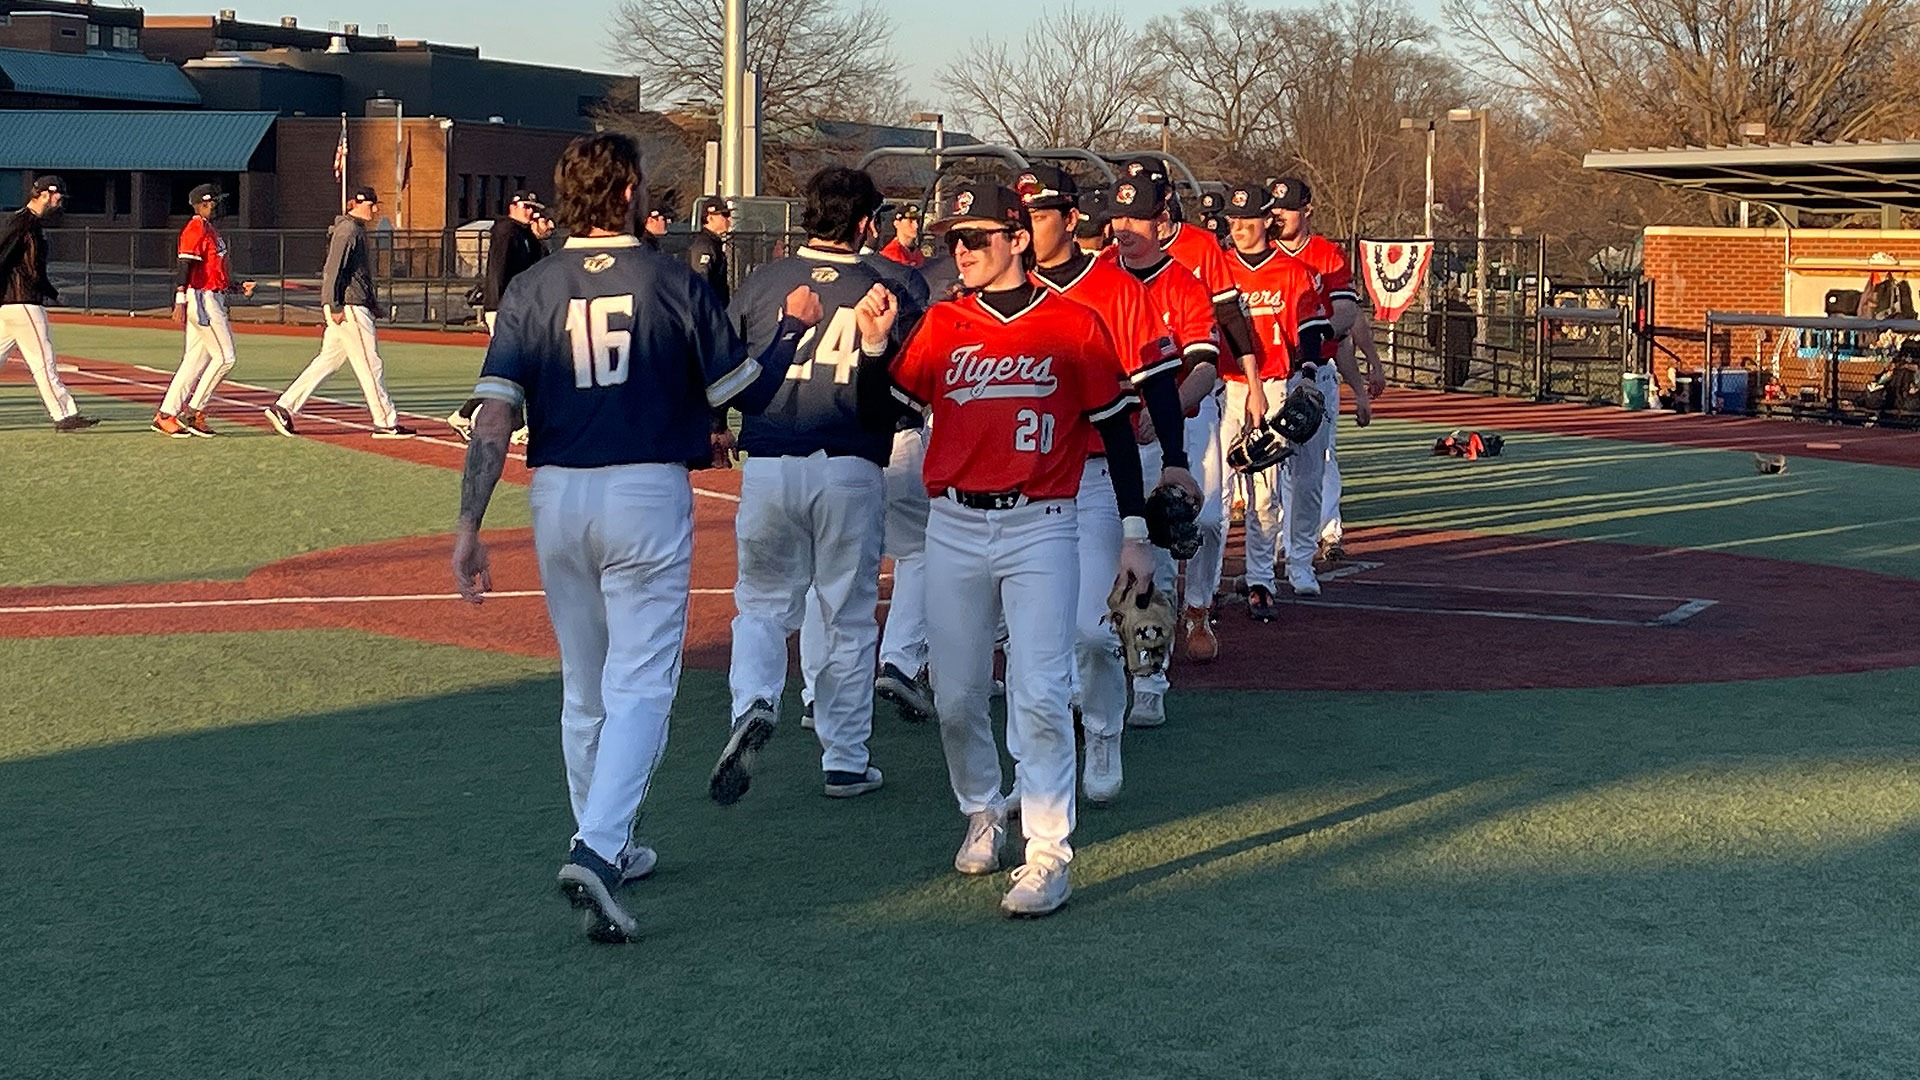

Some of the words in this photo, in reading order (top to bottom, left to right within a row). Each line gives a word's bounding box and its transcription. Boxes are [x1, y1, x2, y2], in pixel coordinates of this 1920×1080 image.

[1237, 284, 1285, 314] gers
[565, 294, 634, 388] 16
[1272, 322, 1281, 345] 1
[945, 343, 1057, 398] Tigers
[1015, 409, 1056, 455] 20
